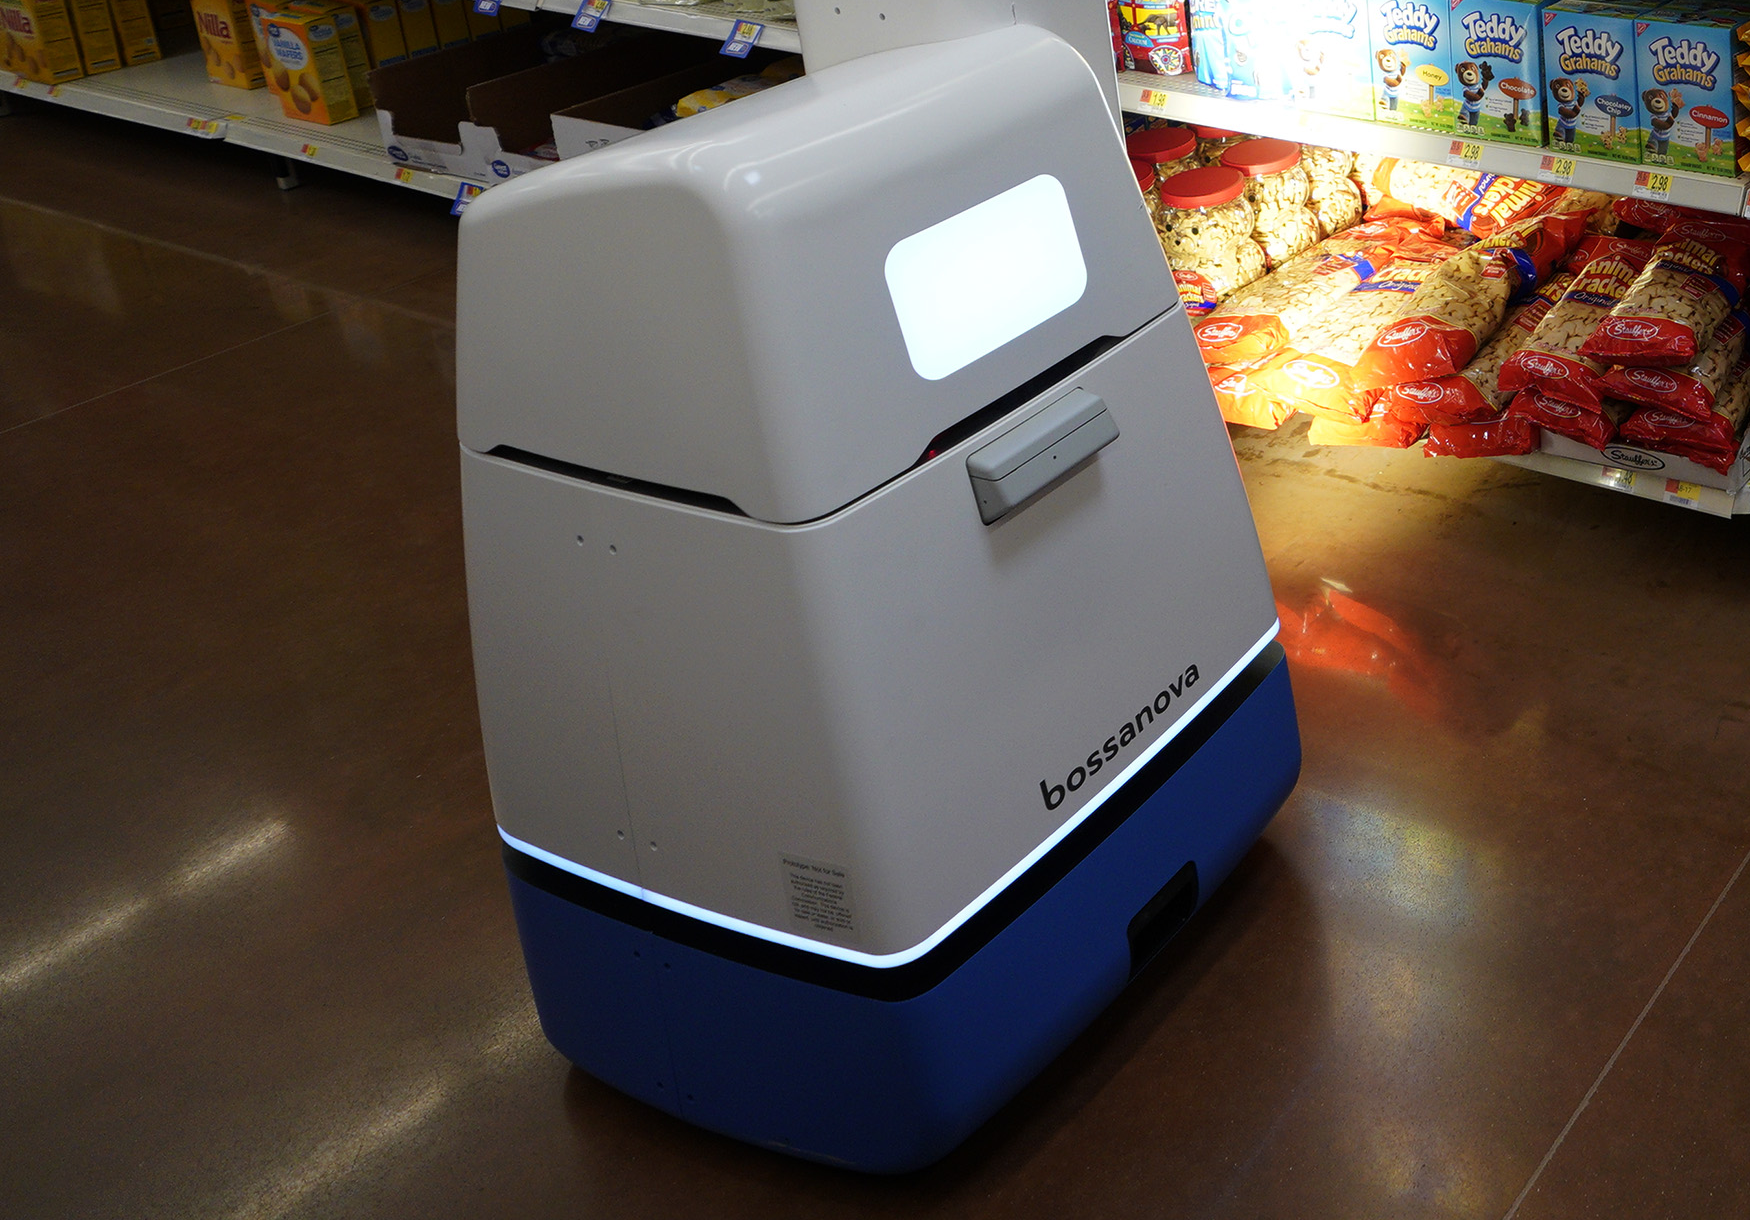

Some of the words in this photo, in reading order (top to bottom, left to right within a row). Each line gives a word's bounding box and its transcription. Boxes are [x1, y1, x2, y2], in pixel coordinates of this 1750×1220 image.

[1462, 13, 1524, 44] Teddy
[1466, 37, 1521, 62] Grahams
[1502, 84, 1534, 94] Chocolate
[1693, 110, 1726, 123] Cinnamon
[1039, 663, 1200, 811] bossanova
